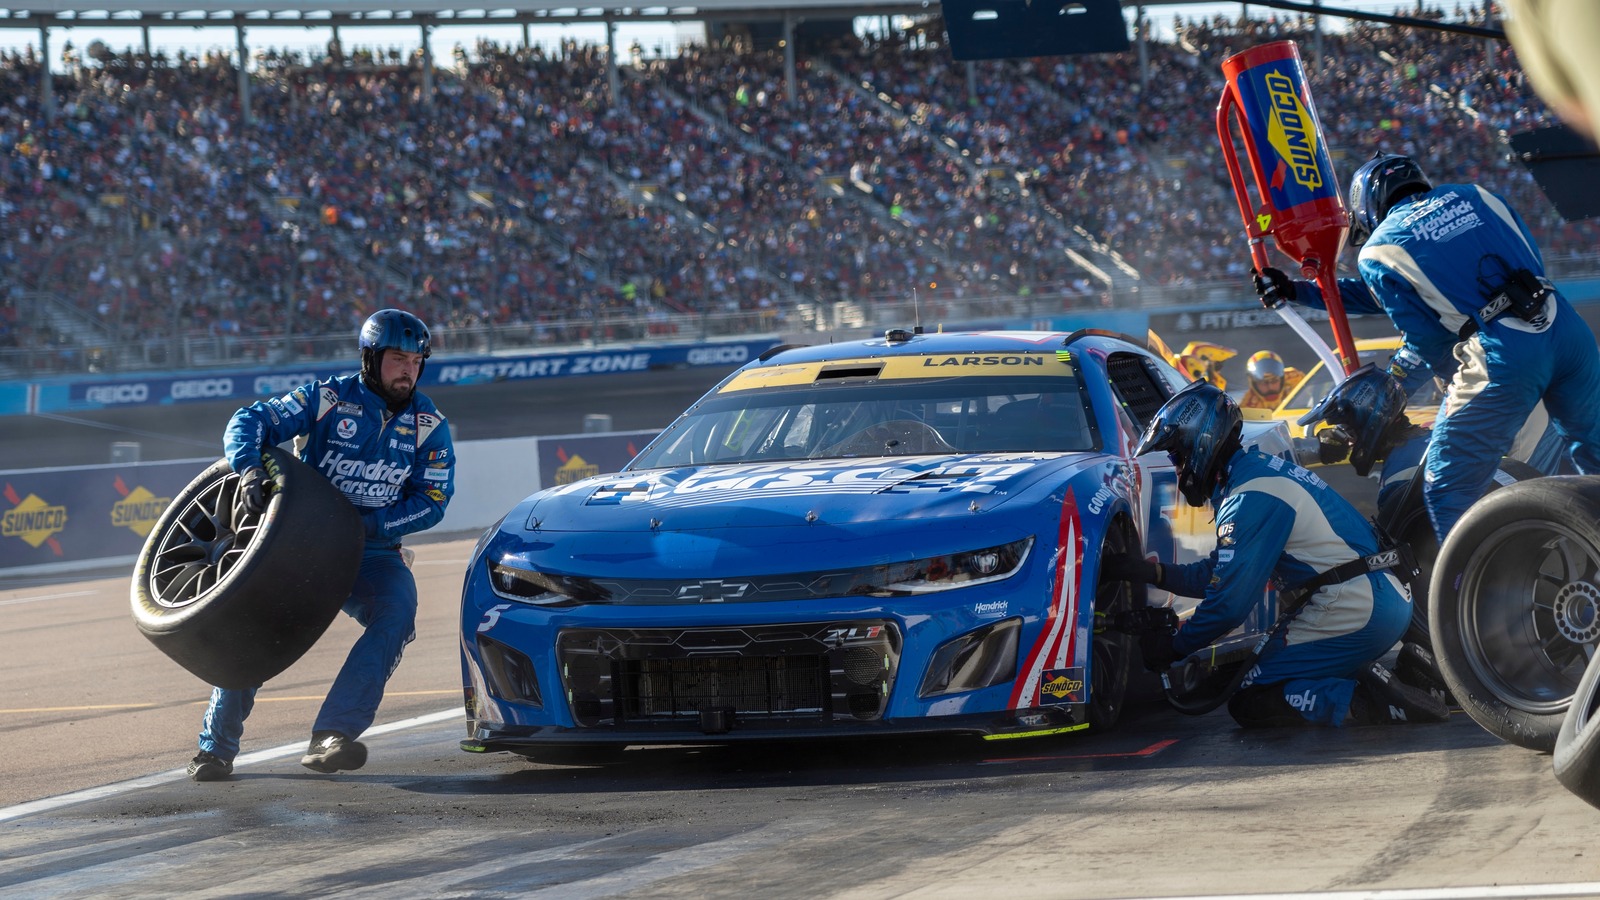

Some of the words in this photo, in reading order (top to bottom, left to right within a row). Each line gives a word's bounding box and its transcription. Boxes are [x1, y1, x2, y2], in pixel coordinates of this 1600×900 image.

[1267, 76, 1320, 184] SUNOCO
[1256, 214, 1272, 232] 4
[1411, 200, 1474, 241] Hendrick
[1430, 212, 1479, 241] Cars.com
[687, 345, 749, 365] GEICO
[923, 356, 1044, 367] LARSON
[438, 358, 568, 382] RESTART
[570, 354, 650, 374] ZONE
[86, 383, 149, 404] GEICO
[171, 378, 234, 400] GEICO
[319, 449, 412, 485] Hendrick
[330, 475, 401, 497] Cars.com
[4, 508, 64, 533] SUNOCO
[477, 604, 512, 632] 5
[974, 600, 1008, 614] Hendrick
[823, 625, 882, 642] ZL1
[1043, 681, 1081, 693] SUNOCO
